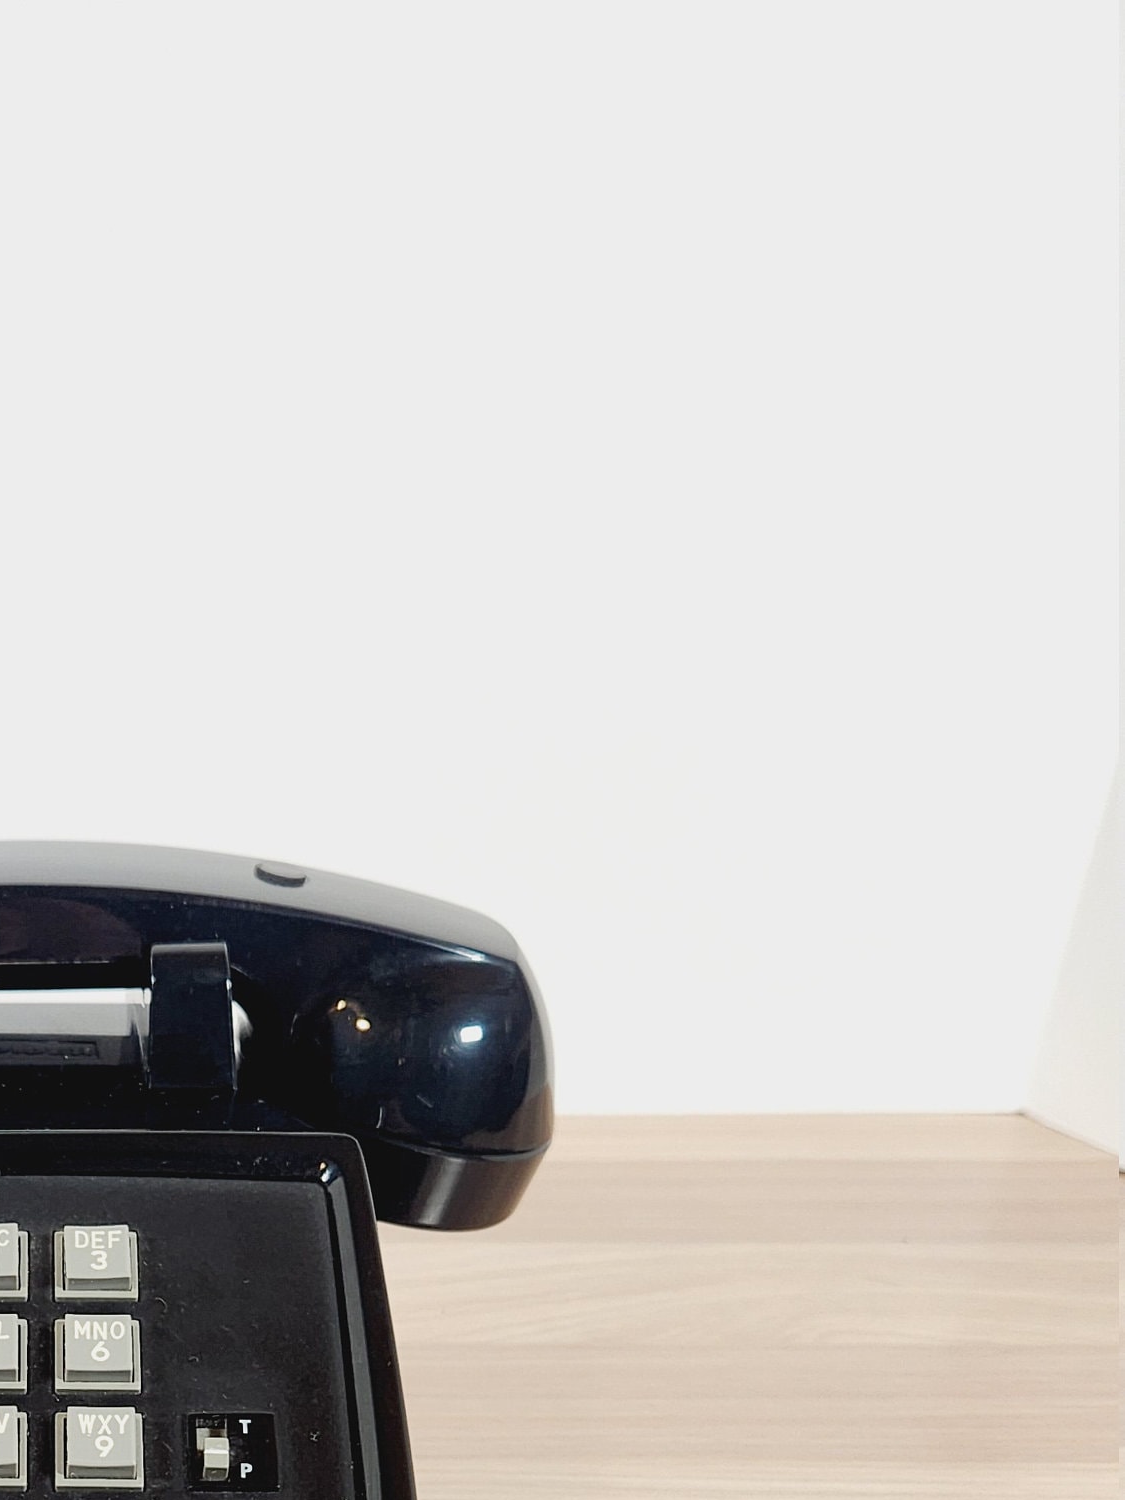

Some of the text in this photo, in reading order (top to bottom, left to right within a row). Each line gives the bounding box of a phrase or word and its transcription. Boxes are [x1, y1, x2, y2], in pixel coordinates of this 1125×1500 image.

[74, 1230, 122, 1249] DEF
[90, 1250, 108, 1271] 3
[74, 1319, 125, 1340] MNO
[90, 1341, 110, 1362] 6
[77, 1413, 130, 1435] WXY
[238, 1419, 252, 1434] T
[94, 1435, 114, 1458] 9
[240, 1462, 253, 1479] P
